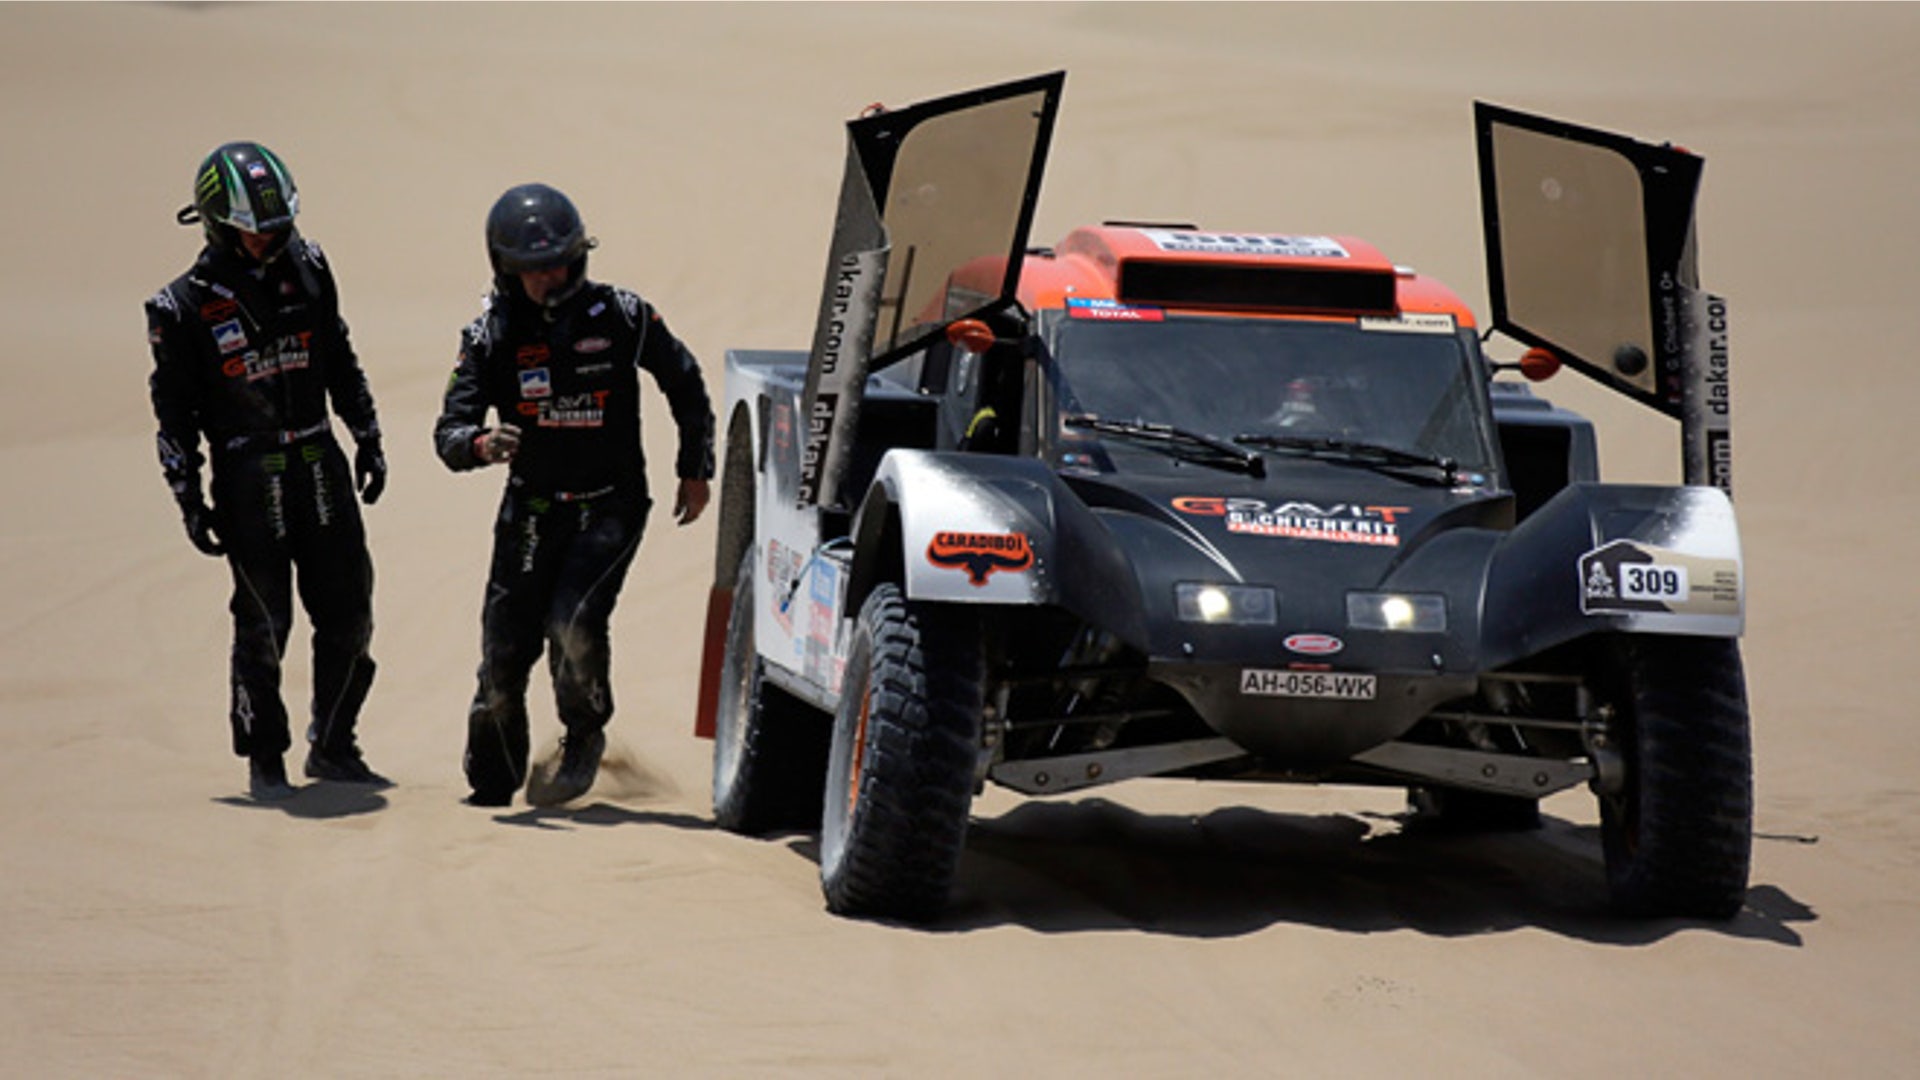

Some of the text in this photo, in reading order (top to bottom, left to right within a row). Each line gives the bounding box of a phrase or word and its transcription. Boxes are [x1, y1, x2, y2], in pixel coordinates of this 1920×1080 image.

[1089, 308, 1142, 320] TOTAL
[1627, 567, 1679, 595] 309
[1243, 671, 1374, 698] AH-056-WK
